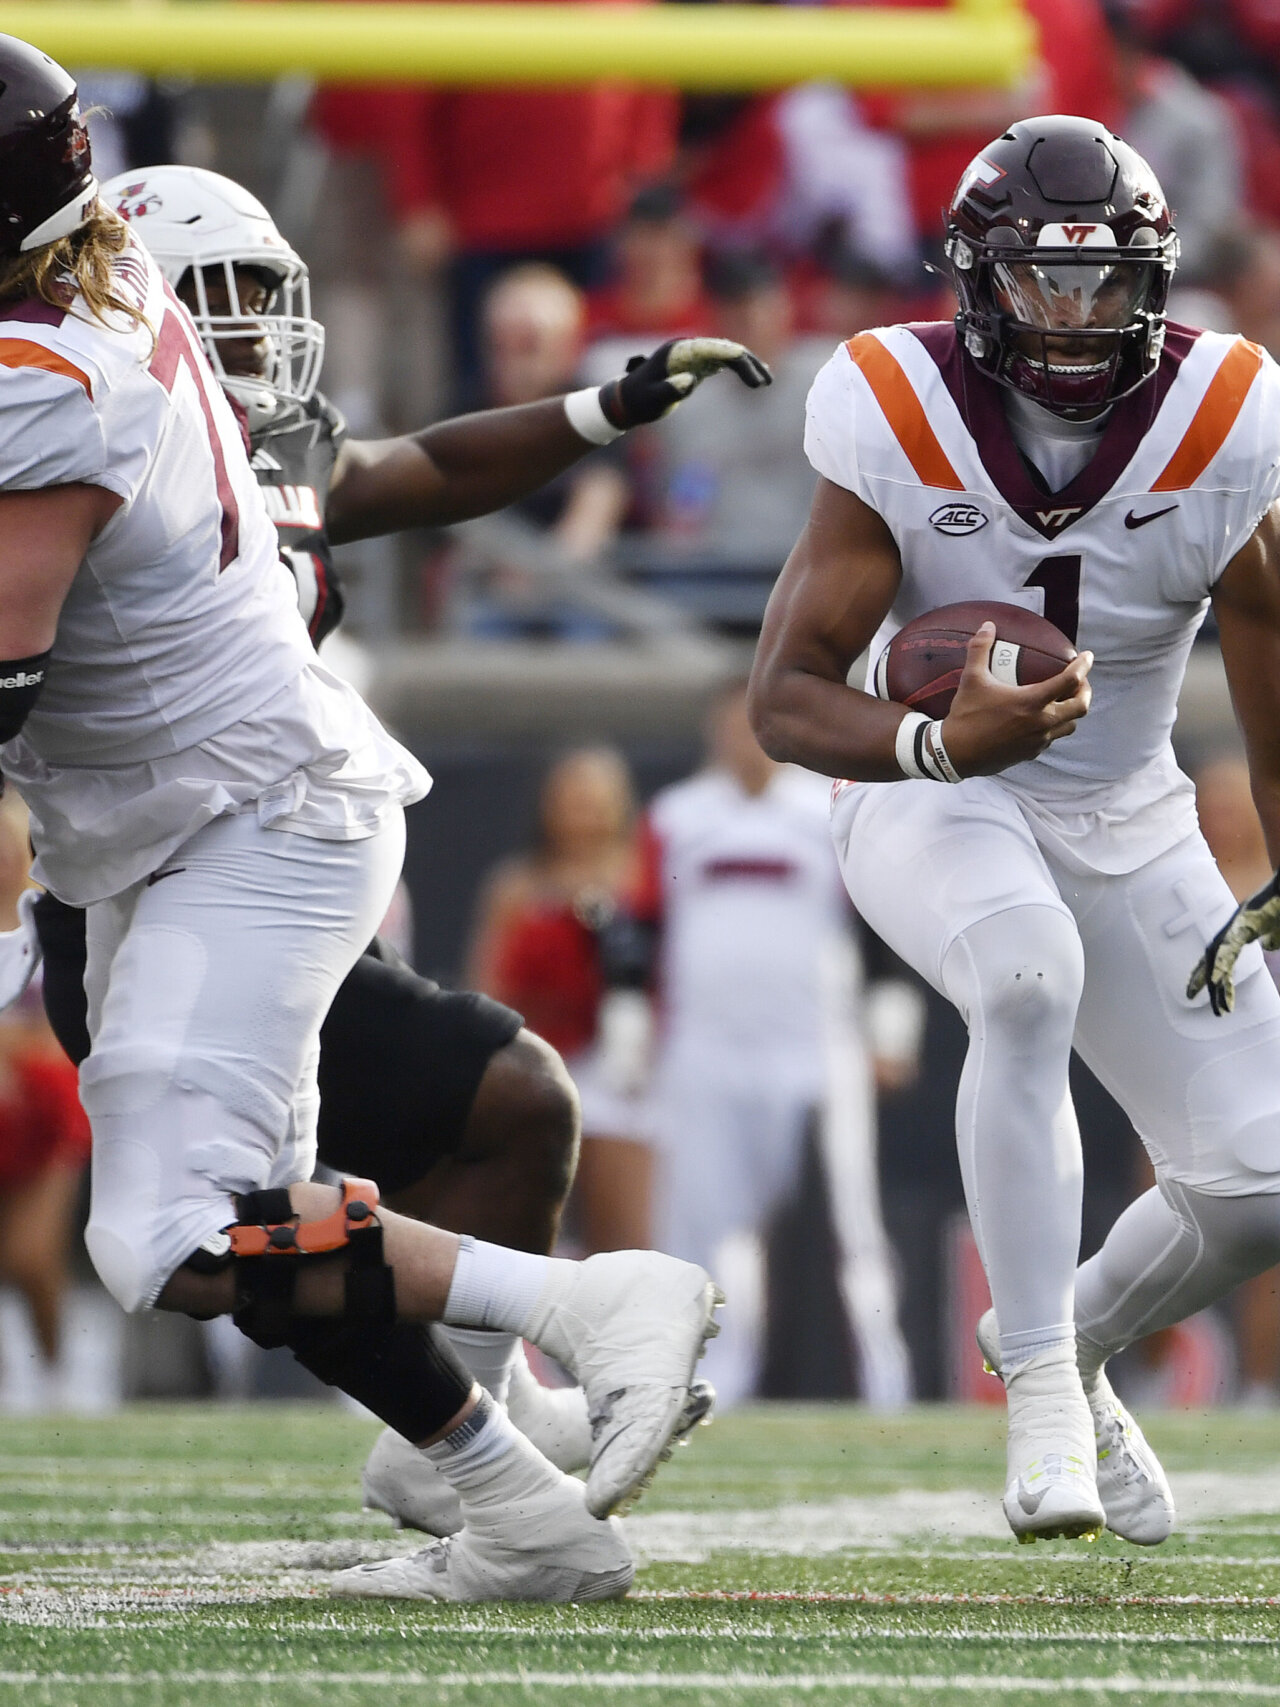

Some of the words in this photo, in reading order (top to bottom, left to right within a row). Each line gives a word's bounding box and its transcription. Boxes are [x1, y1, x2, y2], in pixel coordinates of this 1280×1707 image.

[1061, 225, 1097, 244] VT
[938, 511, 981, 523] ACC
[1035, 507, 1082, 527] VT
[1020, 551, 1085, 650] 1
